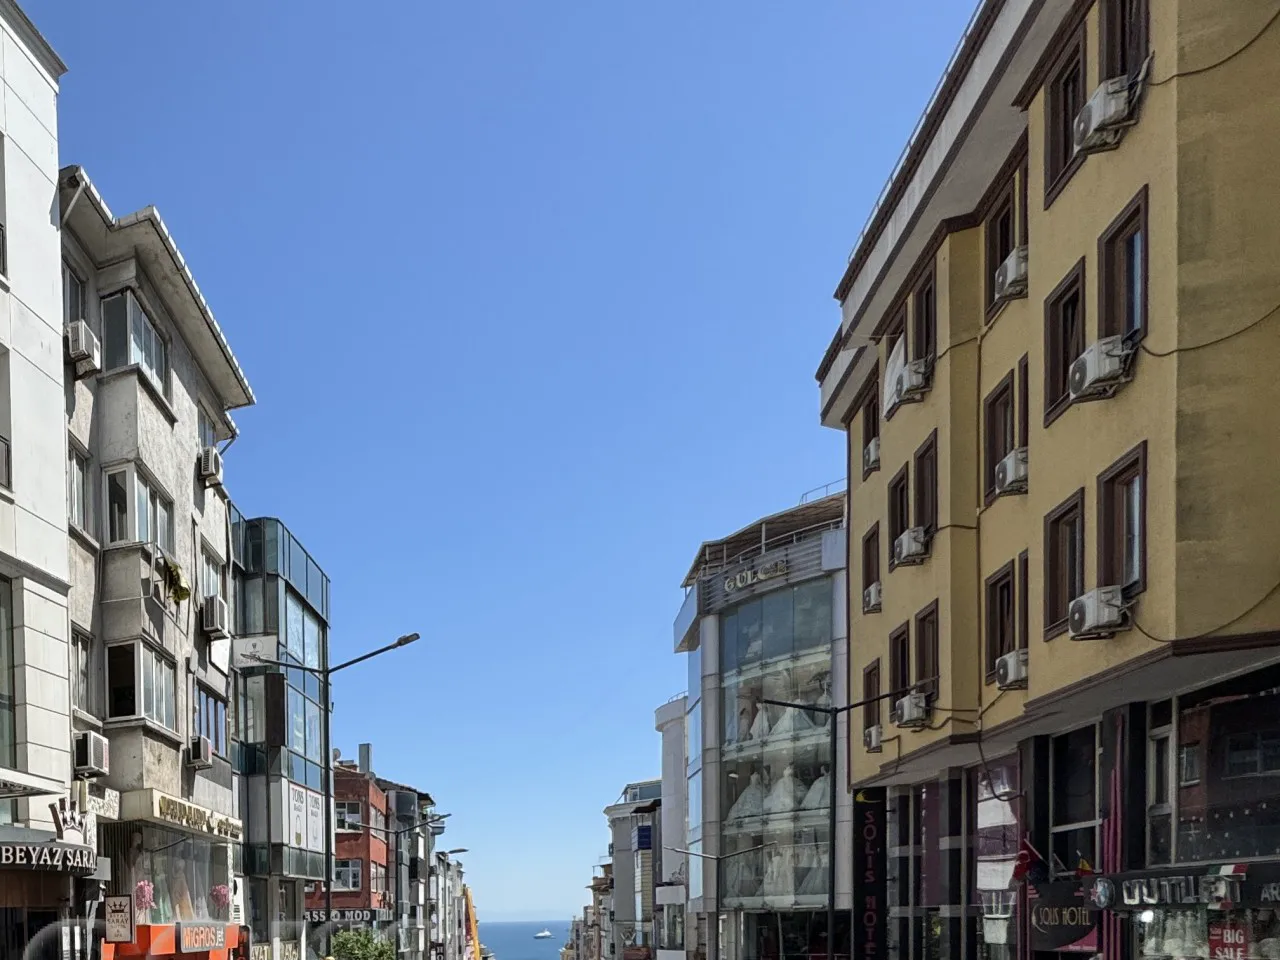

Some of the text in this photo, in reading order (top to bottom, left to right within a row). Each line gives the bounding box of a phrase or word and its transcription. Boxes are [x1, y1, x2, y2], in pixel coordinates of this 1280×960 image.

[863, 810, 877, 884] SOLIS
[1, 845, 97, 869] BEYAZ SARA
[1039, 907, 1091, 926] SOLIS HOTEL
[1223, 929, 1245, 944] BIG
[1215, 946, 1245, 960] SALE
